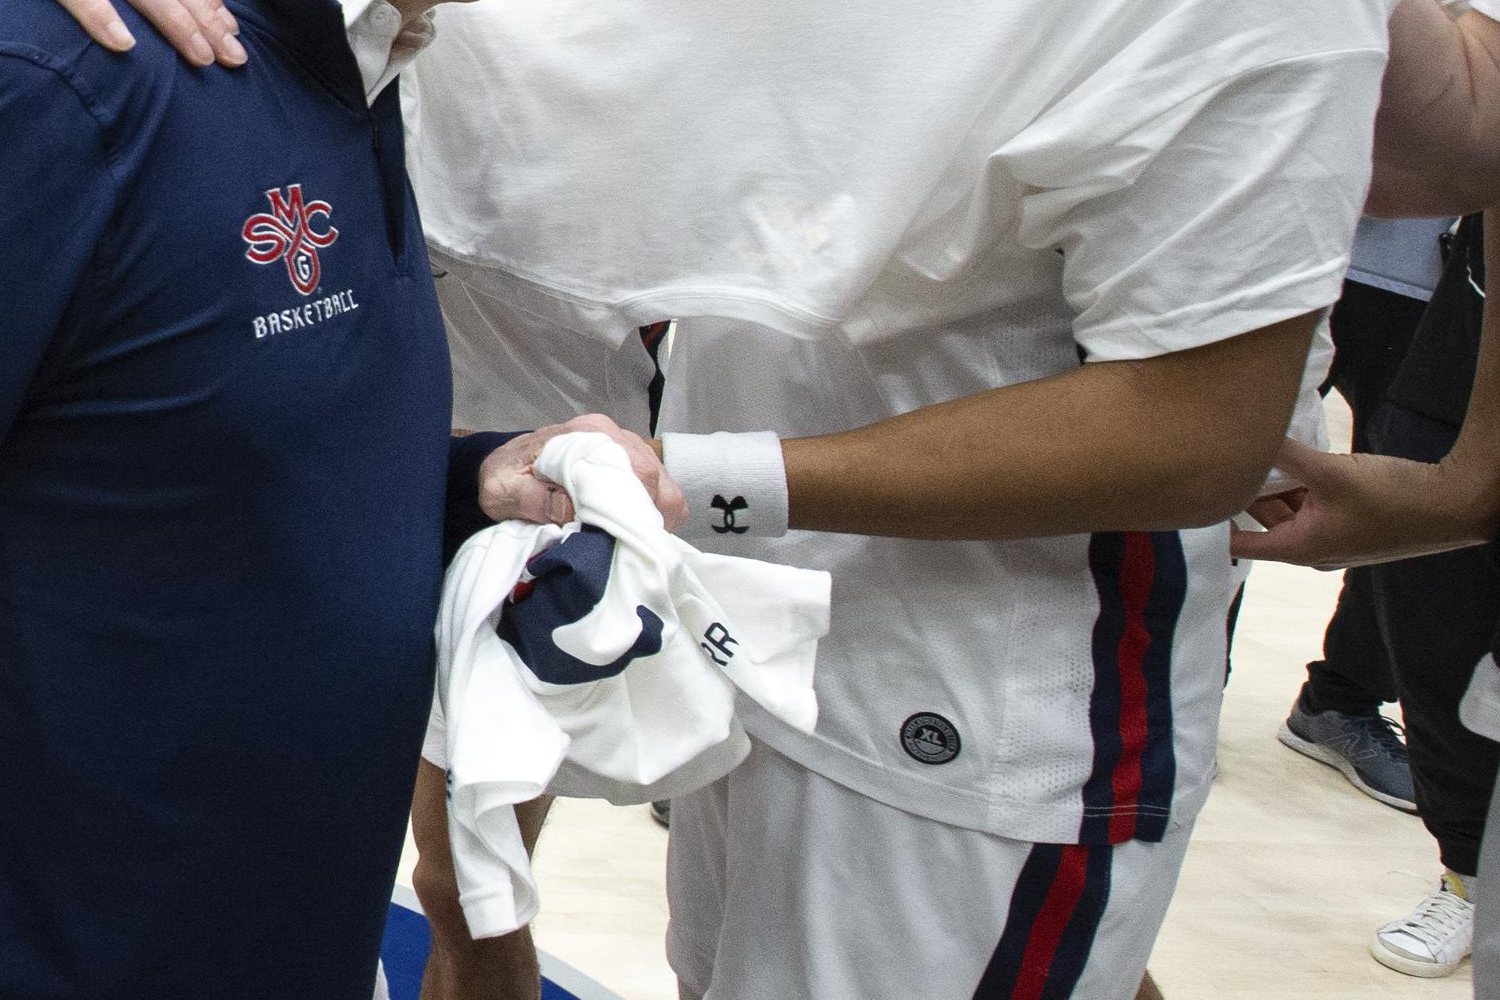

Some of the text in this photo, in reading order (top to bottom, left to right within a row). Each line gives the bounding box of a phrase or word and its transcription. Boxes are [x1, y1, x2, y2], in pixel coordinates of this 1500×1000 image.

[242, 183, 339, 296] SMC
[252, 289, 359, 339] BASKETBALL
[919, 728, 943, 745] XL
